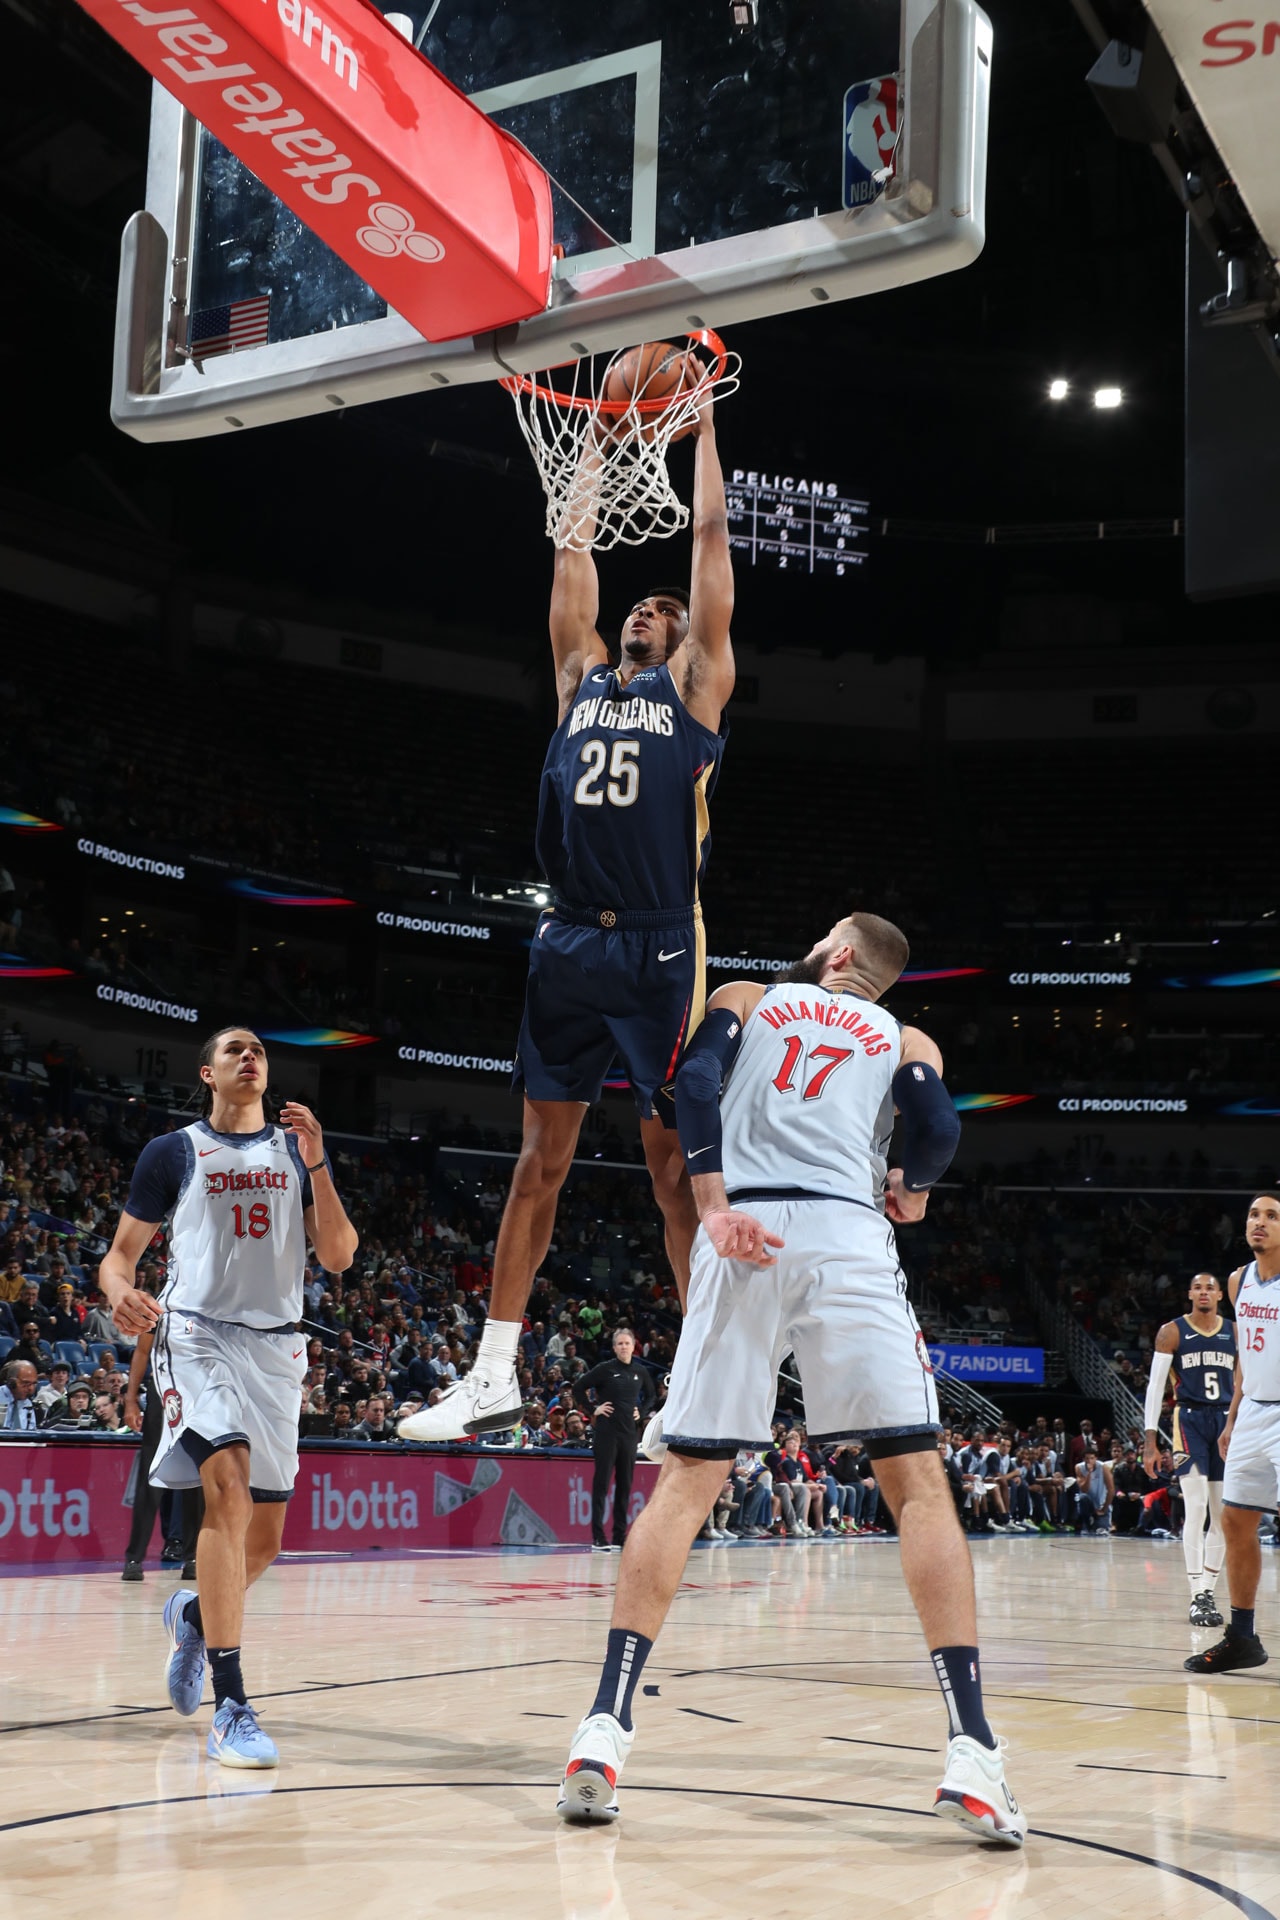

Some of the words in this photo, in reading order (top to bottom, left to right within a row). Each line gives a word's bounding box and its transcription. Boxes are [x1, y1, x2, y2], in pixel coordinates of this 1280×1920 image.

[116, 0, 256, 83] Far
[263, 0, 358, 91] arm
[222, 82, 381, 204] State
[850, 180, 877, 203] NBA
[733, 469, 838, 498] PELICANS
[775, 504, 794, 516] 2/4
[832, 512, 852, 525] 2/6
[836, 538, 845, 550] 8
[779, 556, 788, 568] 2
[836, 563, 845, 576] 5
[567, 696, 602, 739] NEW
[598, 696, 674, 737] ORLEANS
[574, 739, 640, 807] 25
[77, 838, 94, 855] CCI
[95, 844, 185, 880] PRODUCTIONS
[376, 911, 394, 926] CCI
[396, 915, 491, 939] PRODUCTIONS
[1009, 972, 1029, 985] CCI
[1032, 972, 1131, 985] PRODUCTIONS
[96, 984, 114, 1001] CCI
[115, 989, 198, 1022] PRODUCTIONS
[136, 1047, 168, 1079] 115
[398, 1046, 416, 1060] CCI
[418, 1049, 514, 1073] PRODUCTIONS
[772, 1035, 855, 1101] 17
[1058, 1099, 1079, 1111] CCI
[1082, 1099, 1188, 1112] PRODUCTIONS
[205, 1167, 288, 1195] District
[231, 1202, 272, 1239] 18
[1246, 1327, 1265, 1353] 15
[949, 1355, 1035, 1374] FANDUEL
[1181, 1352, 1201, 1370] NEW
[1204, 1371, 1220, 1401] 5
[311, 1472, 419, 1531] ibotta
